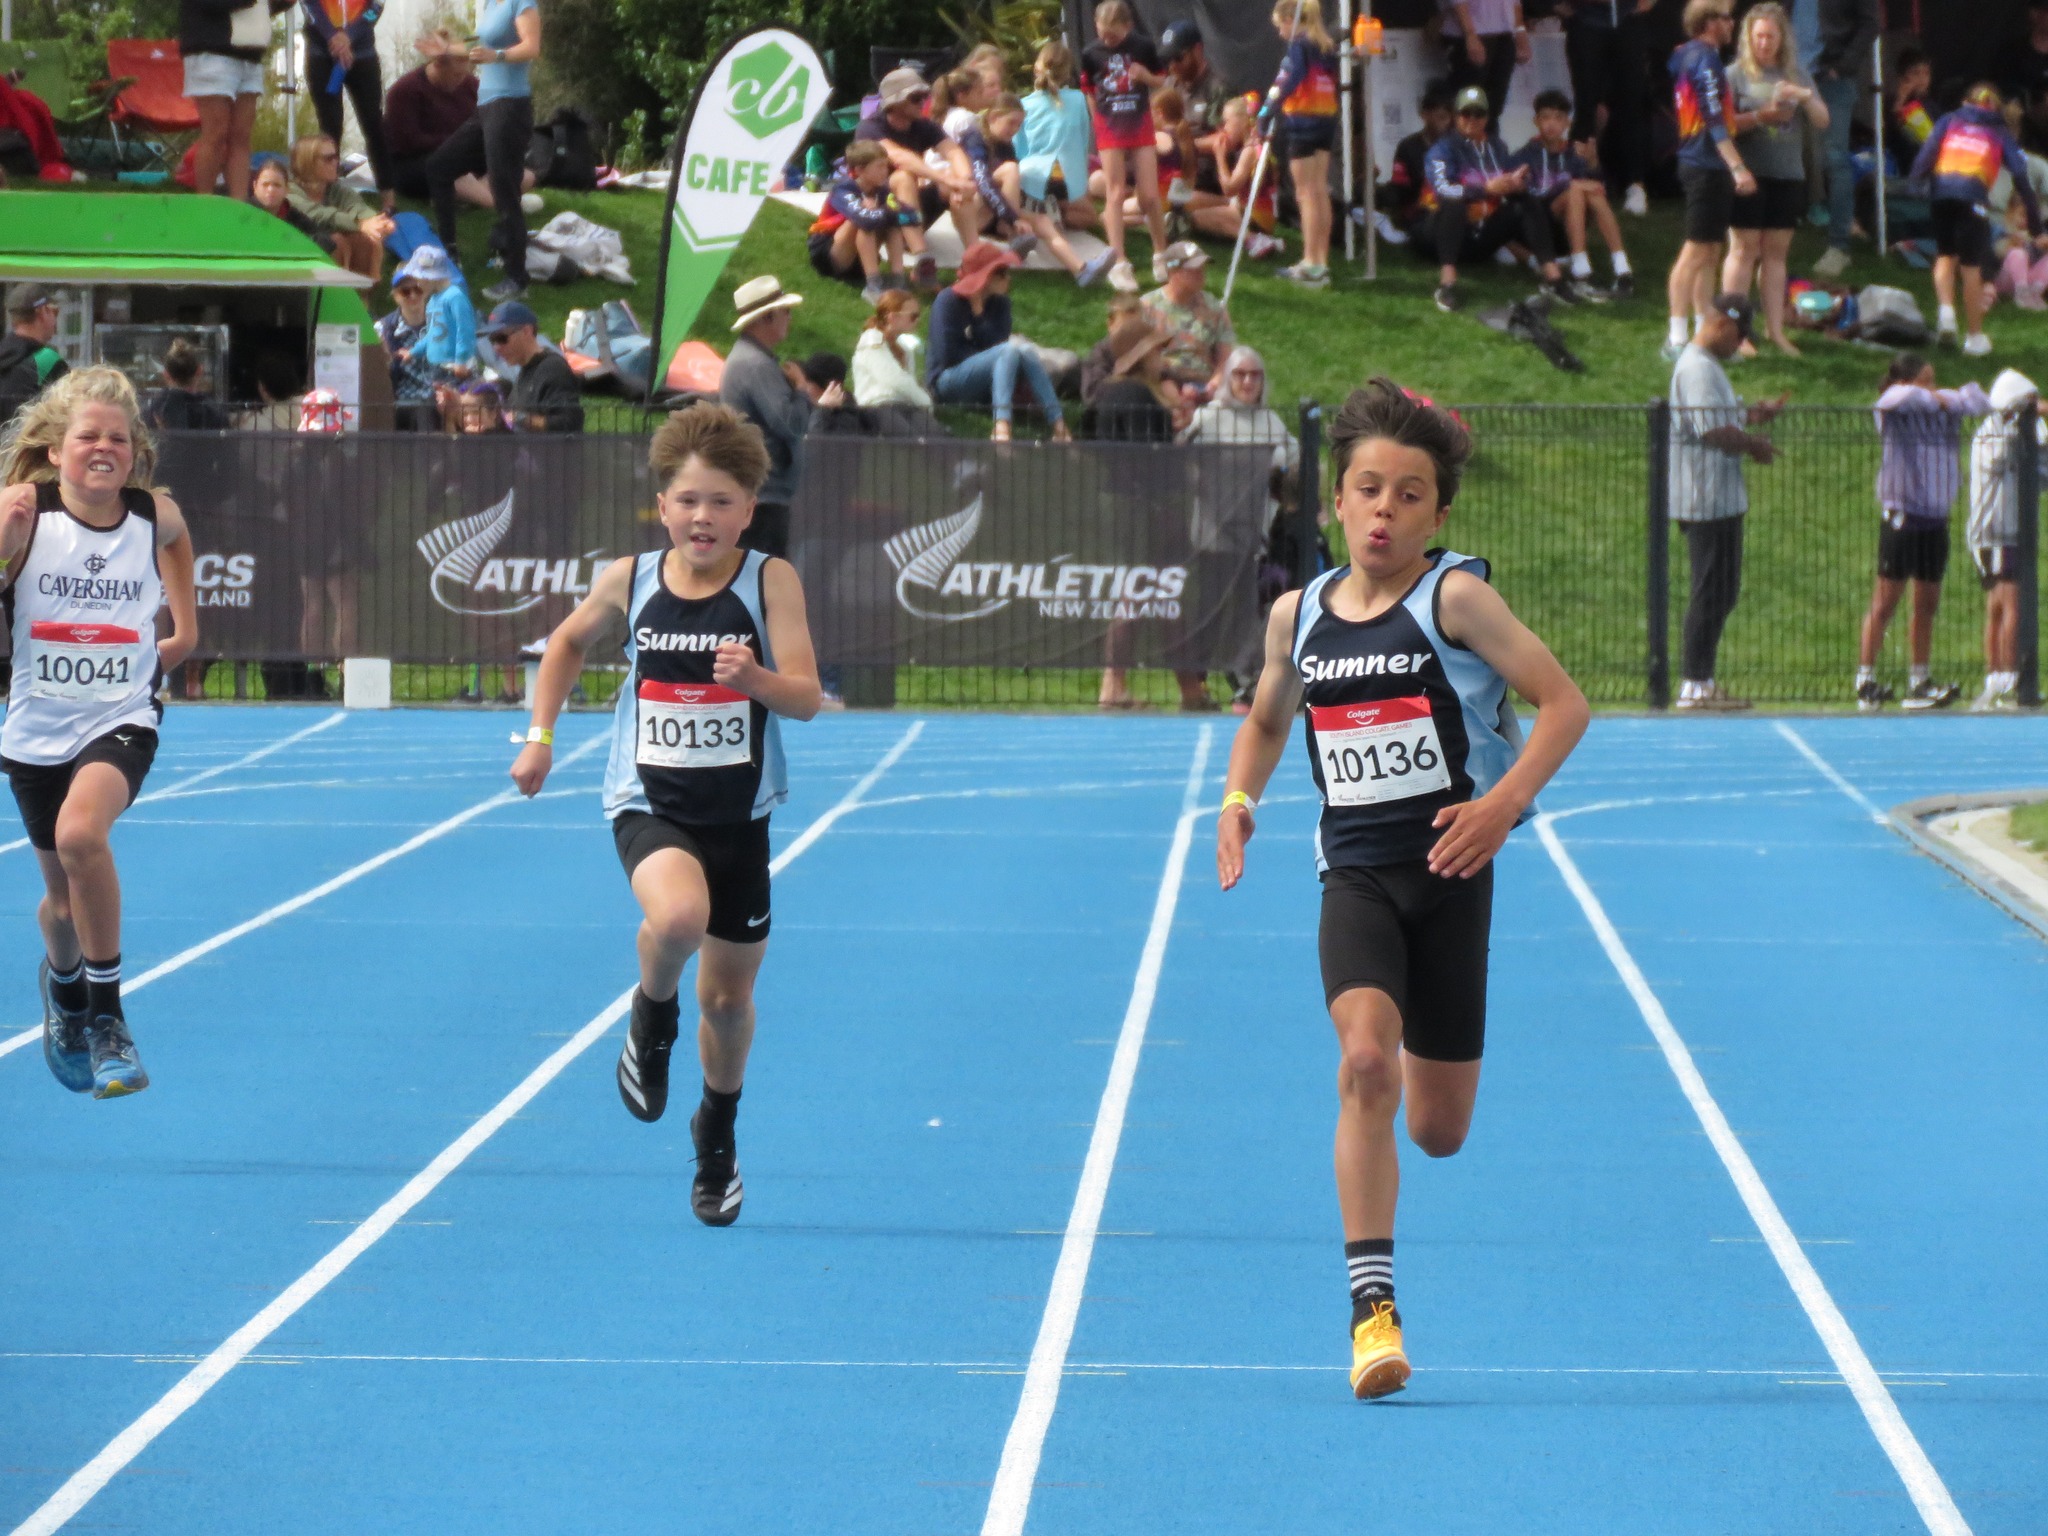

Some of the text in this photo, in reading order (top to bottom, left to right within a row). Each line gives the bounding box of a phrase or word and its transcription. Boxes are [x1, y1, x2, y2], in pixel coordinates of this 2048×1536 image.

[685, 152, 771, 197] CAFE
[38, 573, 144, 602] CAVERSHAM
[70, 600, 112, 611] DUNEDIN
[1039, 600, 1181, 619] NEW ZEALAND
[70, 628, 101, 637] Colgate
[36, 654, 130, 686] 10041
[1300, 652, 1432, 684] Sumner
[674, 688, 707, 697] Colgate
[1346, 707, 1381, 720] Colgate
[646, 715, 746, 749] 10133
[1344, 730, 1365, 738] ISLAND
[1365, 725, 1390, 735] COLGATE
[1390, 721, 1412, 731] GAMES
[1327, 734, 1439, 784] 10136
